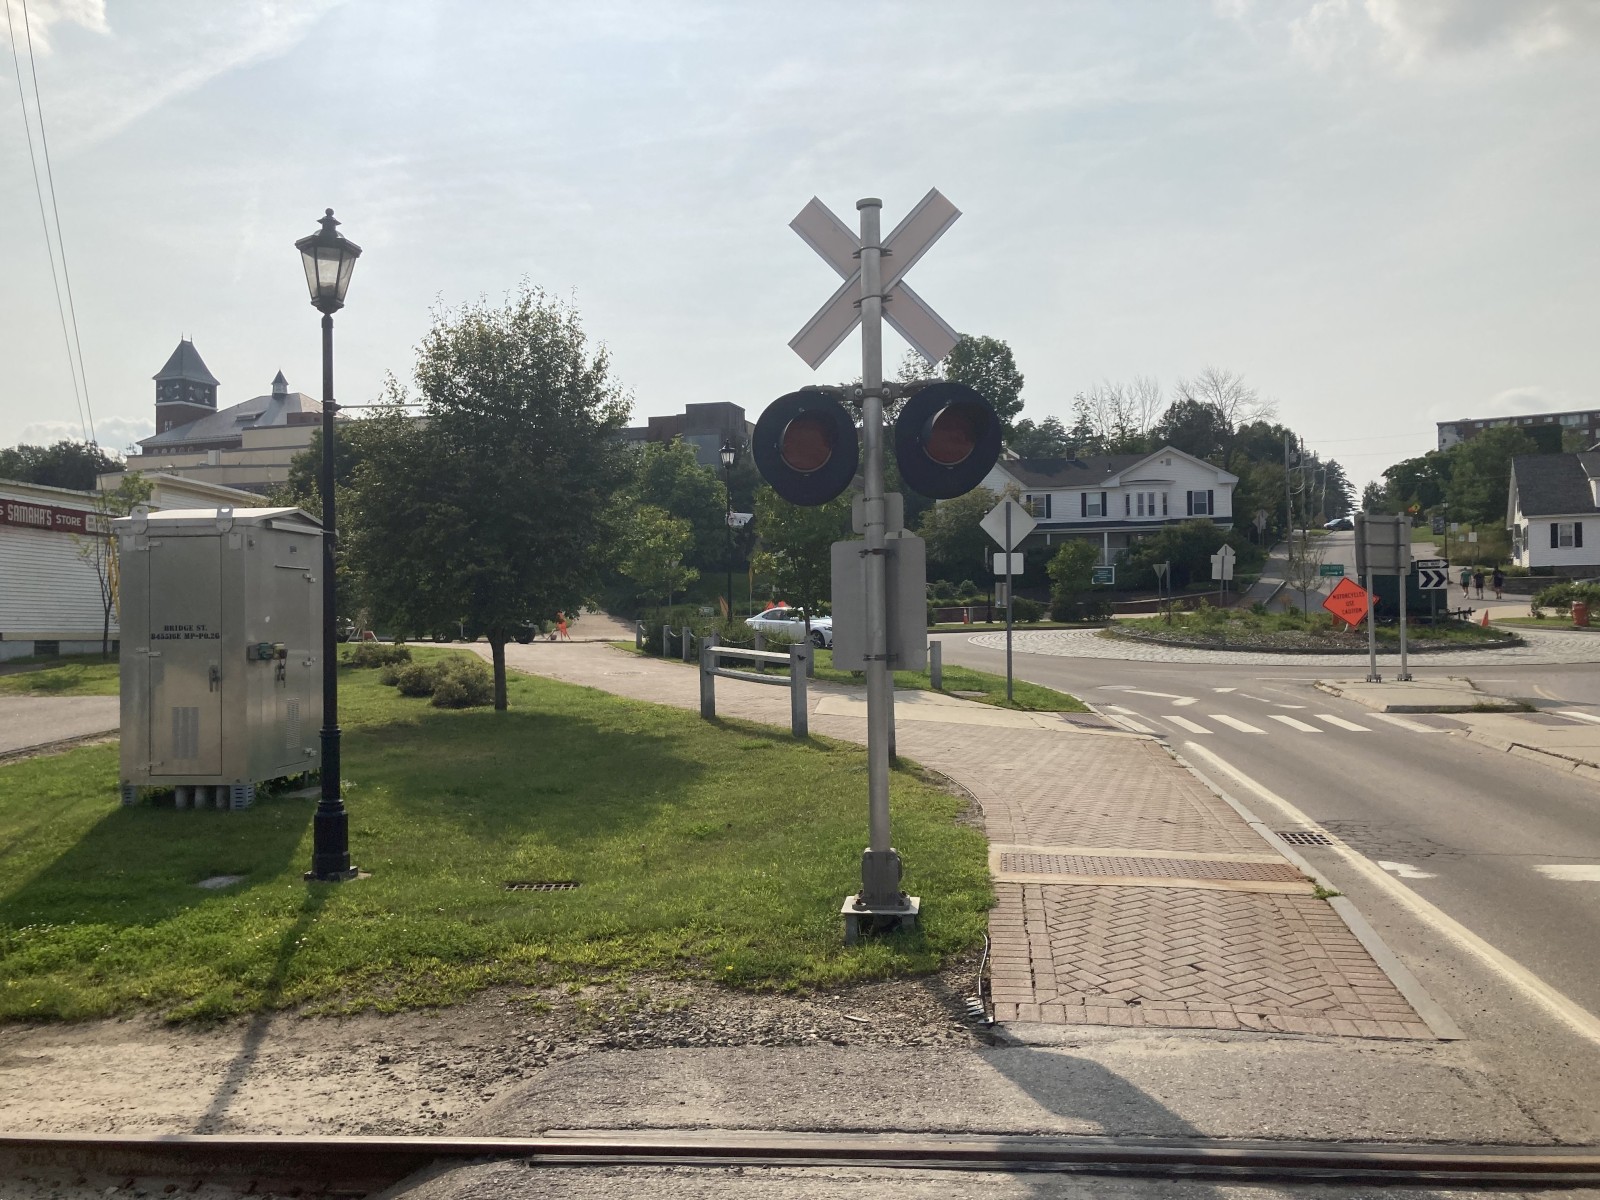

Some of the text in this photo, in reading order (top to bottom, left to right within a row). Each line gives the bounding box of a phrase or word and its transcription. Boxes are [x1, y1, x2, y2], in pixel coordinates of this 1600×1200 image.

[7, 504, 52, 526] SAMAHA'S
[55, 514, 82, 527] STORE
[164, 624, 208, 632] BRIDGE ST.
